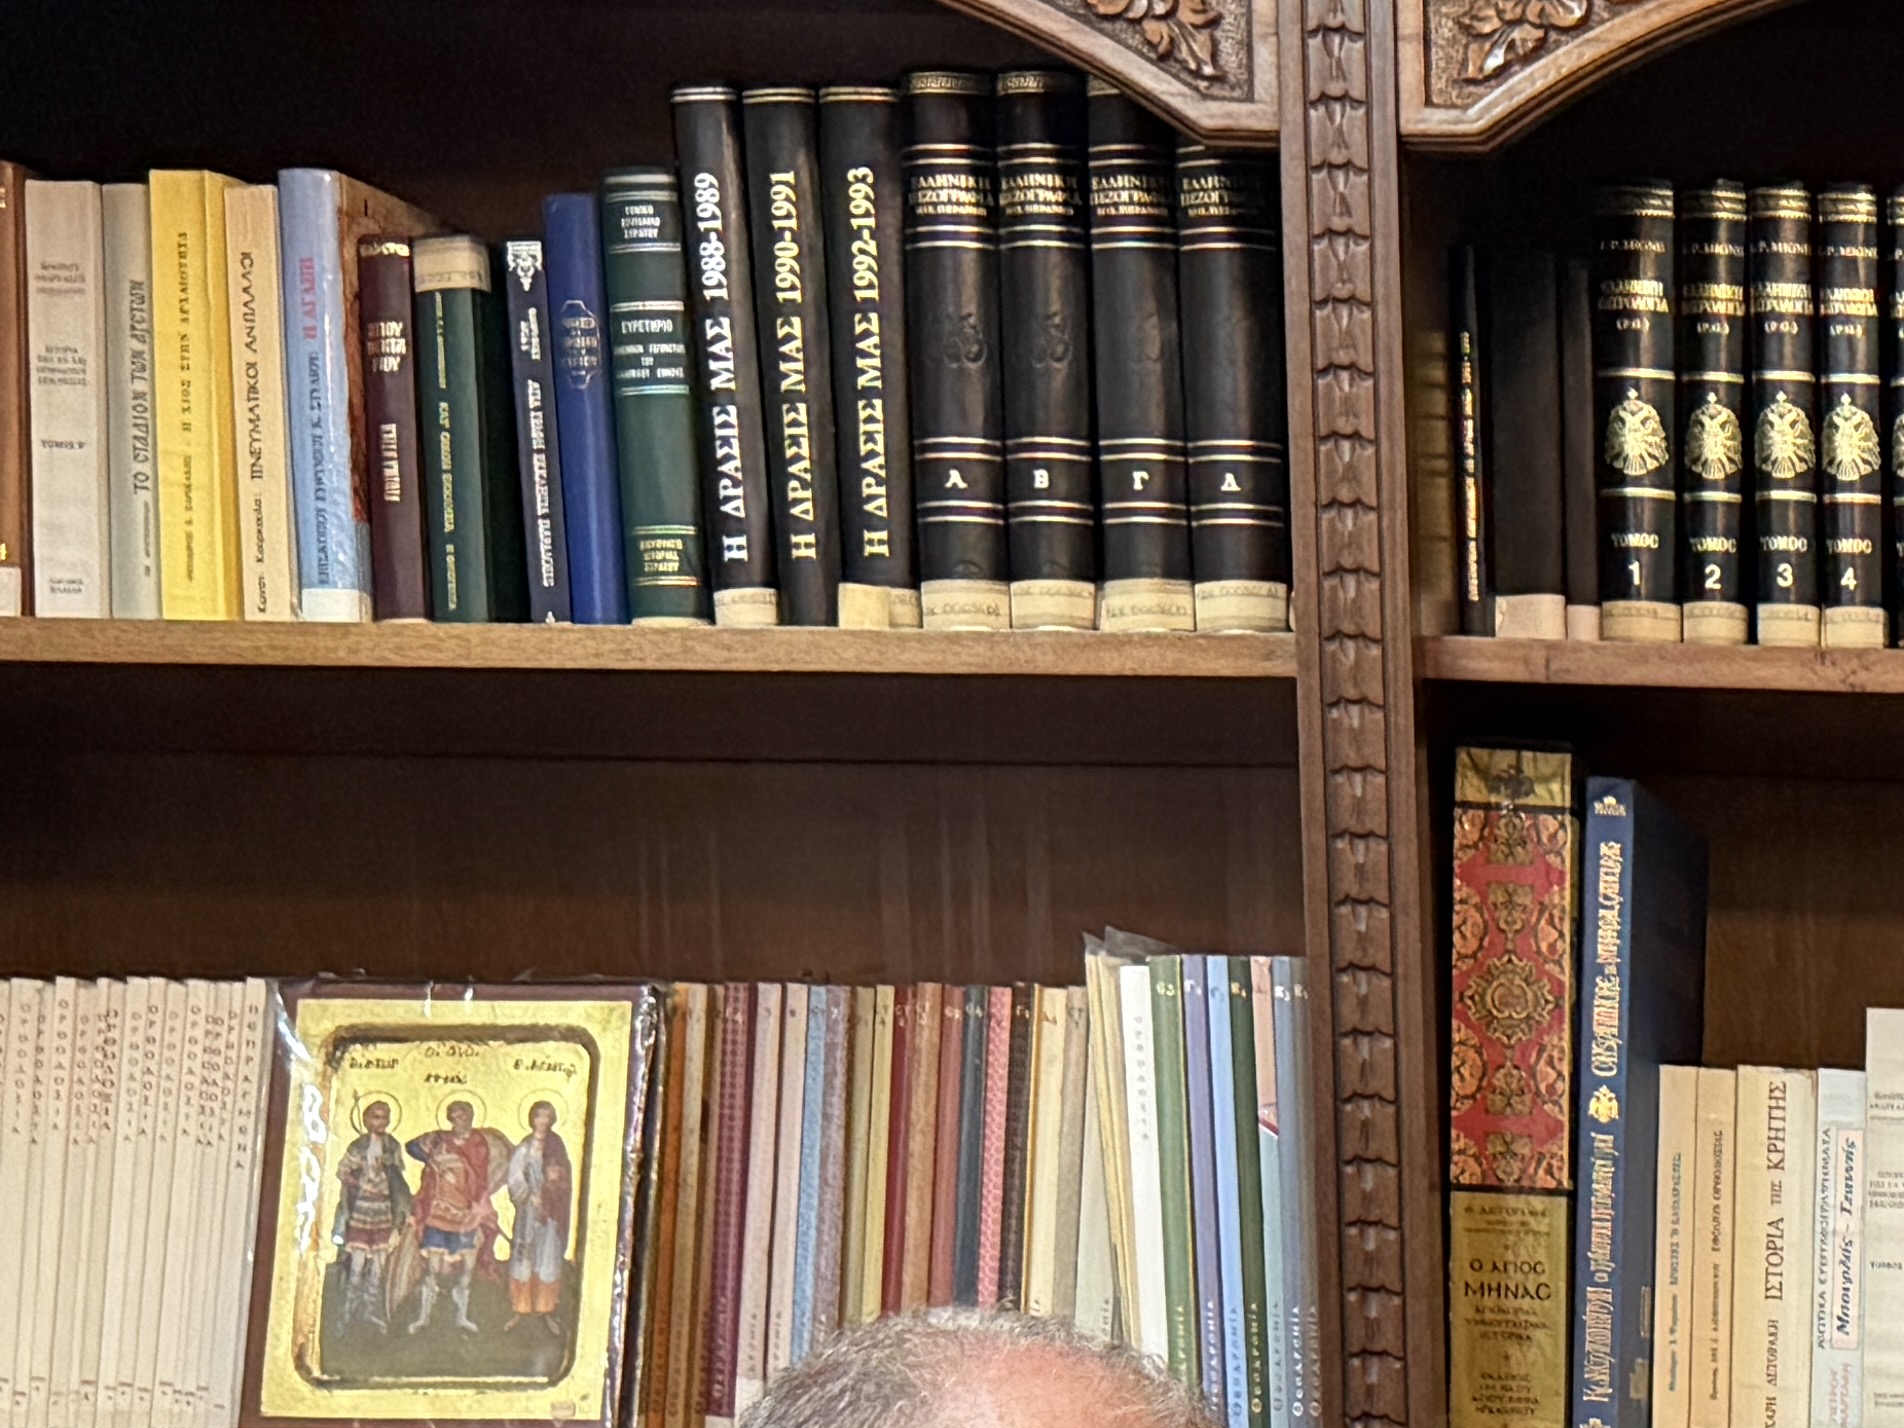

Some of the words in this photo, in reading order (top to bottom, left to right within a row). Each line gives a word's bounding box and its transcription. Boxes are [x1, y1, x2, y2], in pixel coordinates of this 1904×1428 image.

[694, 172, 729, 302] 1988-1989
[770, 170, 802, 303] 1990-1991
[847, 167, 880, 303] 1992-1993
[705, 317, 736, 391] ΜΑΣ
[776, 316, 806, 393] ΜΑΣ
[855, 312, 882, 390] ΜΑΣ
[713, 405, 746, 519] ΔΡΑΣΙΣ
[782, 403, 813, 522] ΔΡΑΣΙΣ
[858, 398, 888, 518] ΔΡΑΣΙΣ
[133, 472, 150, 494] ΤΟ
[945, 470, 967, 489] Α
[1034, 469, 1049, 489] Β
[1133, 470, 1149, 490] Γ
[1220, 472, 1241, 491] Δ
[723, 535, 748, 562] Η
[792, 532, 817, 561] Η
[864, 529, 890, 557] Η
[1628, 561, 1640, 584] 1
[1705, 565, 1721, 589] 2
[1777, 563, 1793, 587] 3
[1841, 567, 1857, 589] 4
[1767, 1080, 1787, 1171] ΚΡΗΤΗΣ
[1771, 1180, 1782, 1205] ΤΗΣ
[1469, 1260, 1483, 1274] Ο
[1764, 1218, 1785, 1300] ΙΣΤΟΡΙΑ
